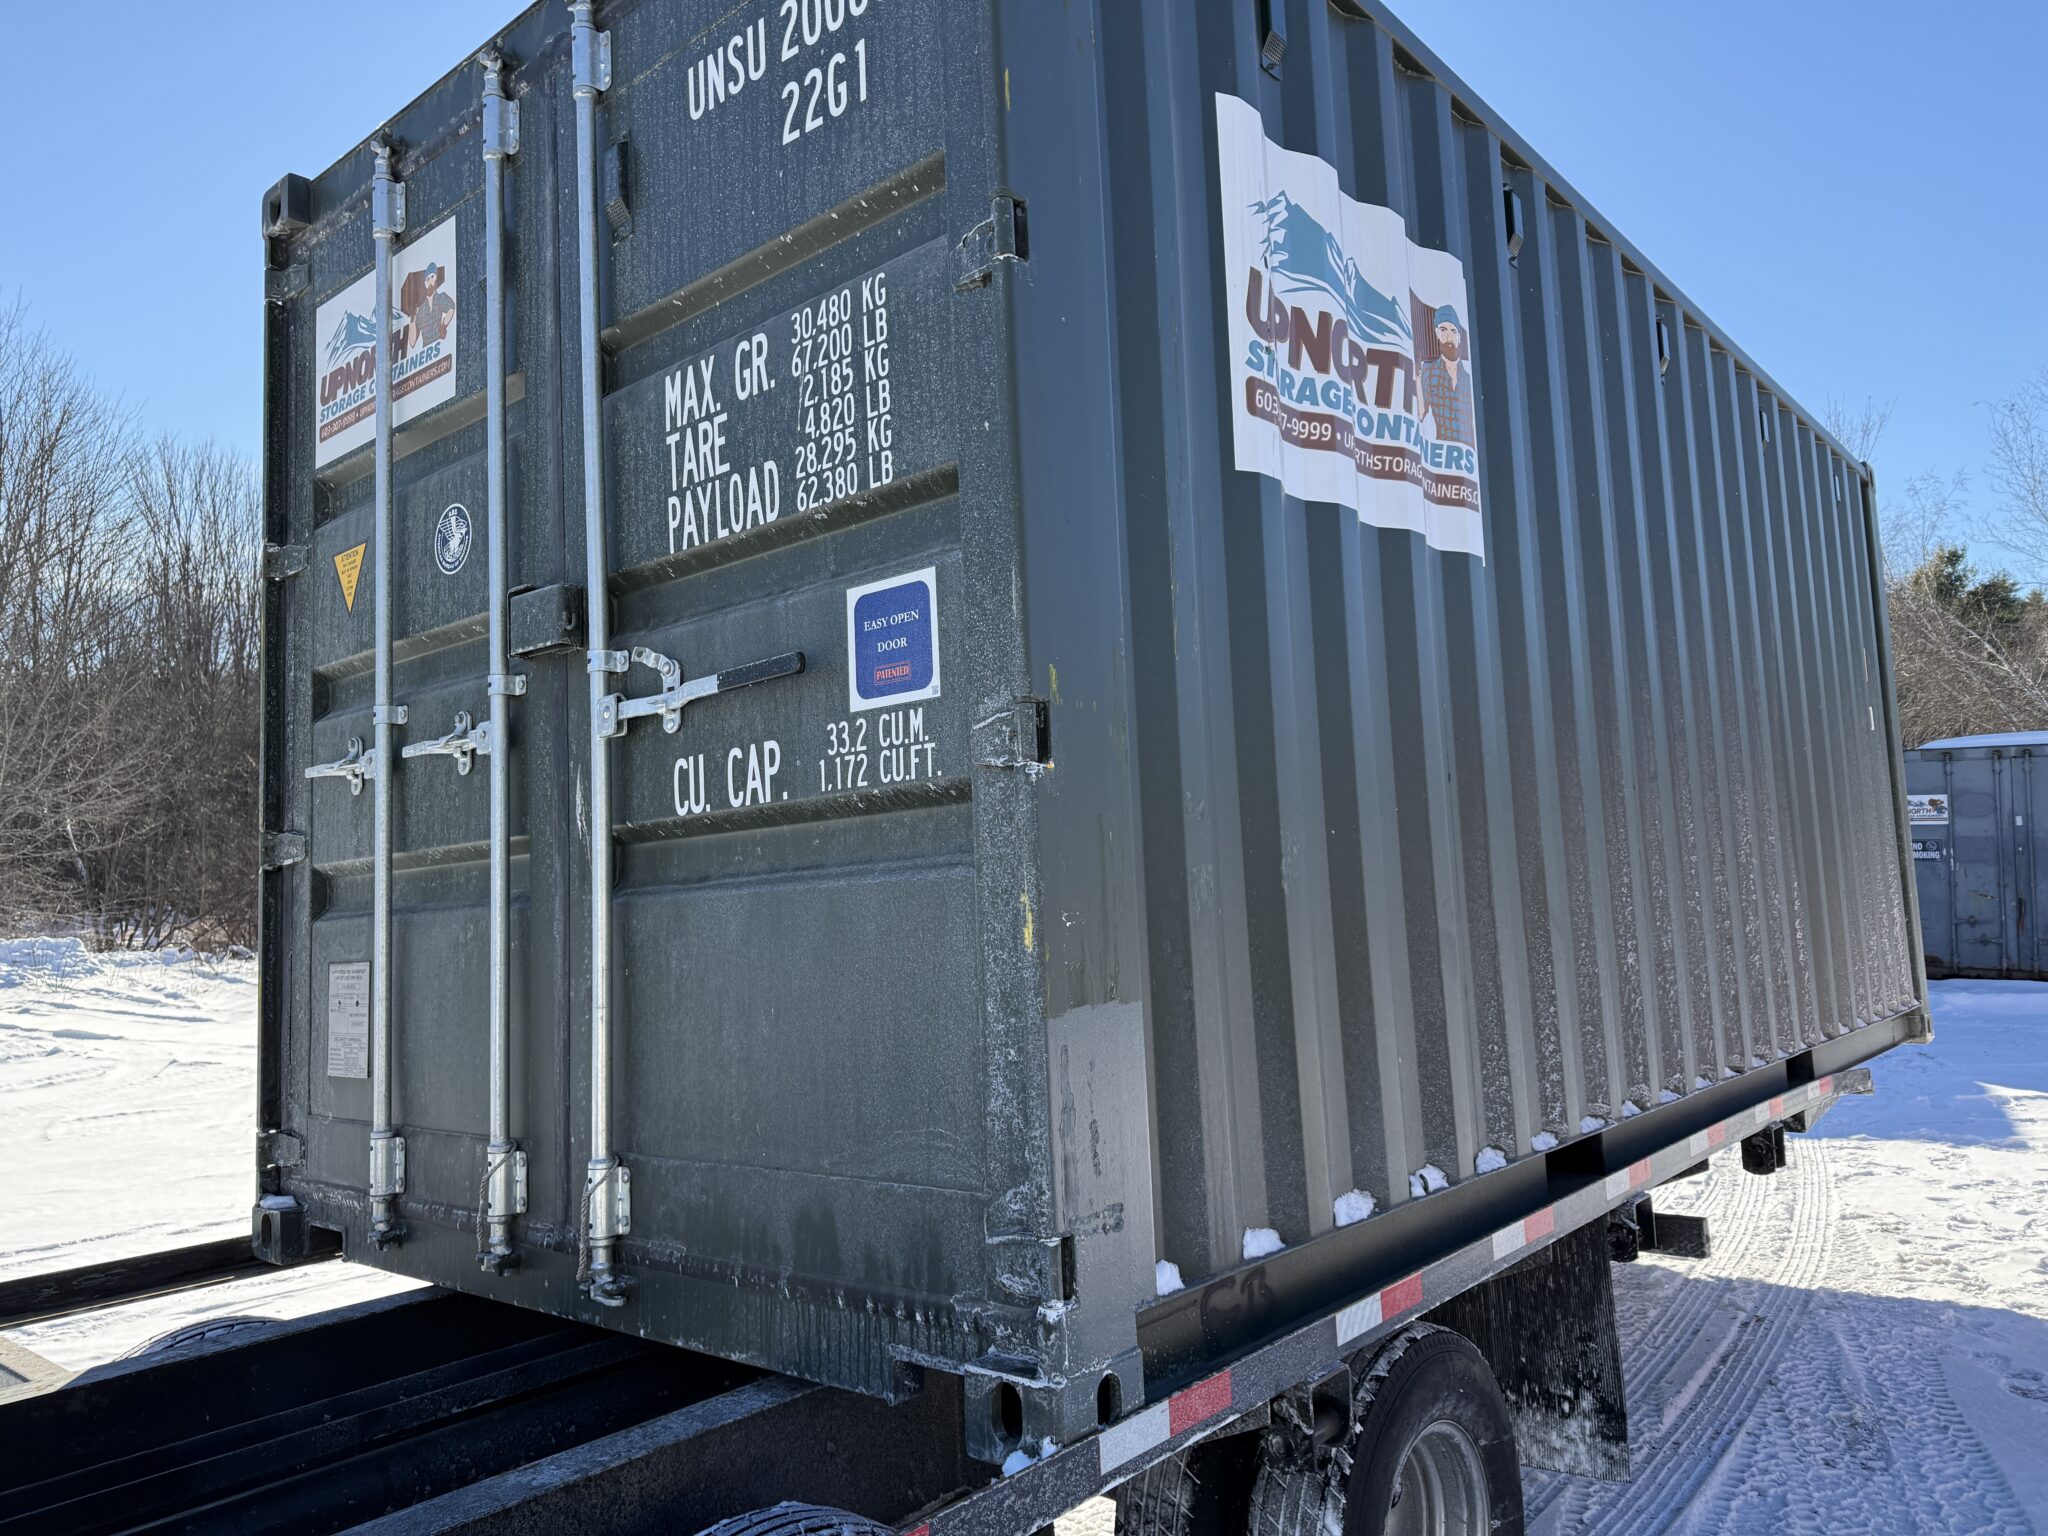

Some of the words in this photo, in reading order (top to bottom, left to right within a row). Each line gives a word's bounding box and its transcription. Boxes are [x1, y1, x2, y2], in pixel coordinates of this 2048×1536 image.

[688, 17, 766, 120] UNSU
[780, 0, 868, 62] 200
[781, 38, 867, 145] 22G1
[665, 355, 721, 432] MAX.
[734, 333, 776, 401] GR.
[791, 288, 851, 344] 30,480
[862, 272, 886, 313] KG
[791, 323, 852, 377] 67,200
[863, 308, 888, 348] LB
[1245, 339, 1356, 418] STRAGE
[320, 384, 367, 424] STORAGE
[369, 341, 441, 395] CTAINERS
[666, 412, 730, 491] TARE
[803, 357, 854, 408] 2,185
[864, 343, 889, 383] KG
[805, 393, 855, 439] 4,820
[866, 379, 891, 419] LB
[668, 460, 780, 554] PAYLOAD
[795, 427, 856, 479] 28,295
[867, 414, 892, 453] KG
[796, 463, 858, 512] 62,380
[869, 450, 893, 489] LB
[863, 616, 888, 631] EASY
[890, 610, 919, 626] OPEN
[877, 637, 907, 652] DOOR
[673, 754, 711, 816] CU.
[727, 740, 788, 808] CAP.
[826, 718, 867, 755] 33.2
[878, 707, 929, 747] CU.M.
[819, 753, 868, 792] 1,172
[879, 742, 942, 783] CU.FT.
[1912, 842, 1923, 850] NO
